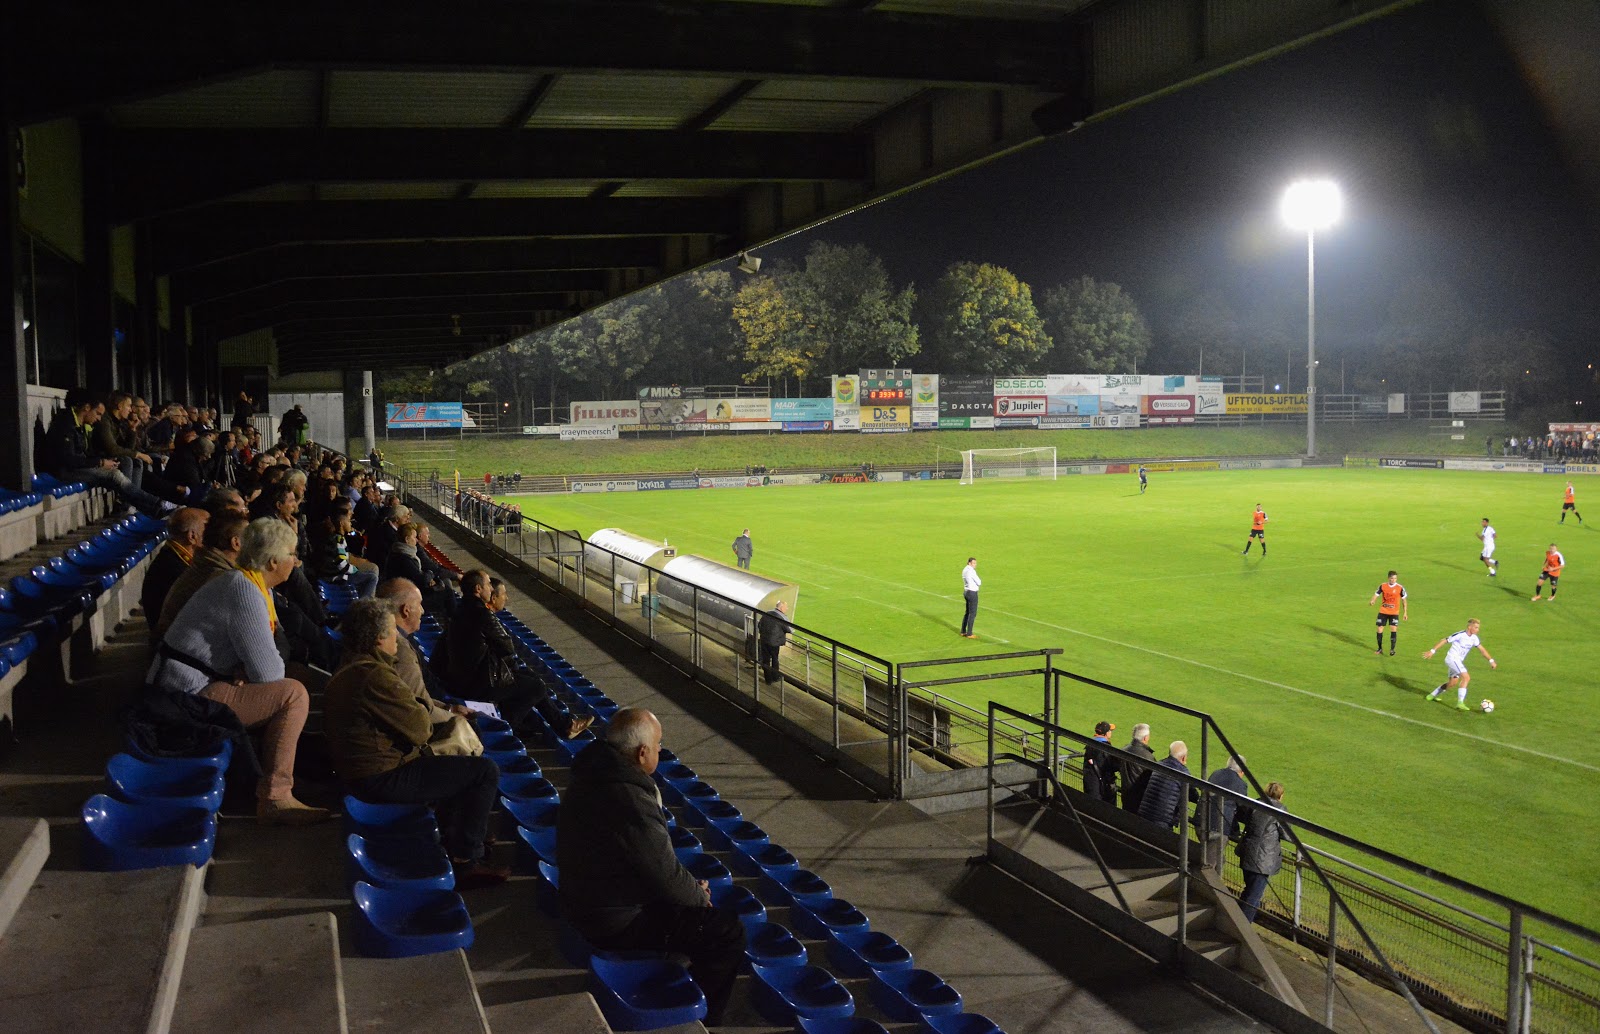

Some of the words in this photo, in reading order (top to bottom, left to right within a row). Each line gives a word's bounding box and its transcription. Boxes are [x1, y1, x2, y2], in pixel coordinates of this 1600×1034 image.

[995, 380, 1046, 388] SO.SE.CO.
[650, 387, 680, 397] MIKS
[1012, 401, 1043, 412] Jupiler
[561, 428, 611, 436] craeymeersch
[1567, 465, 1597, 473] DEBELS
